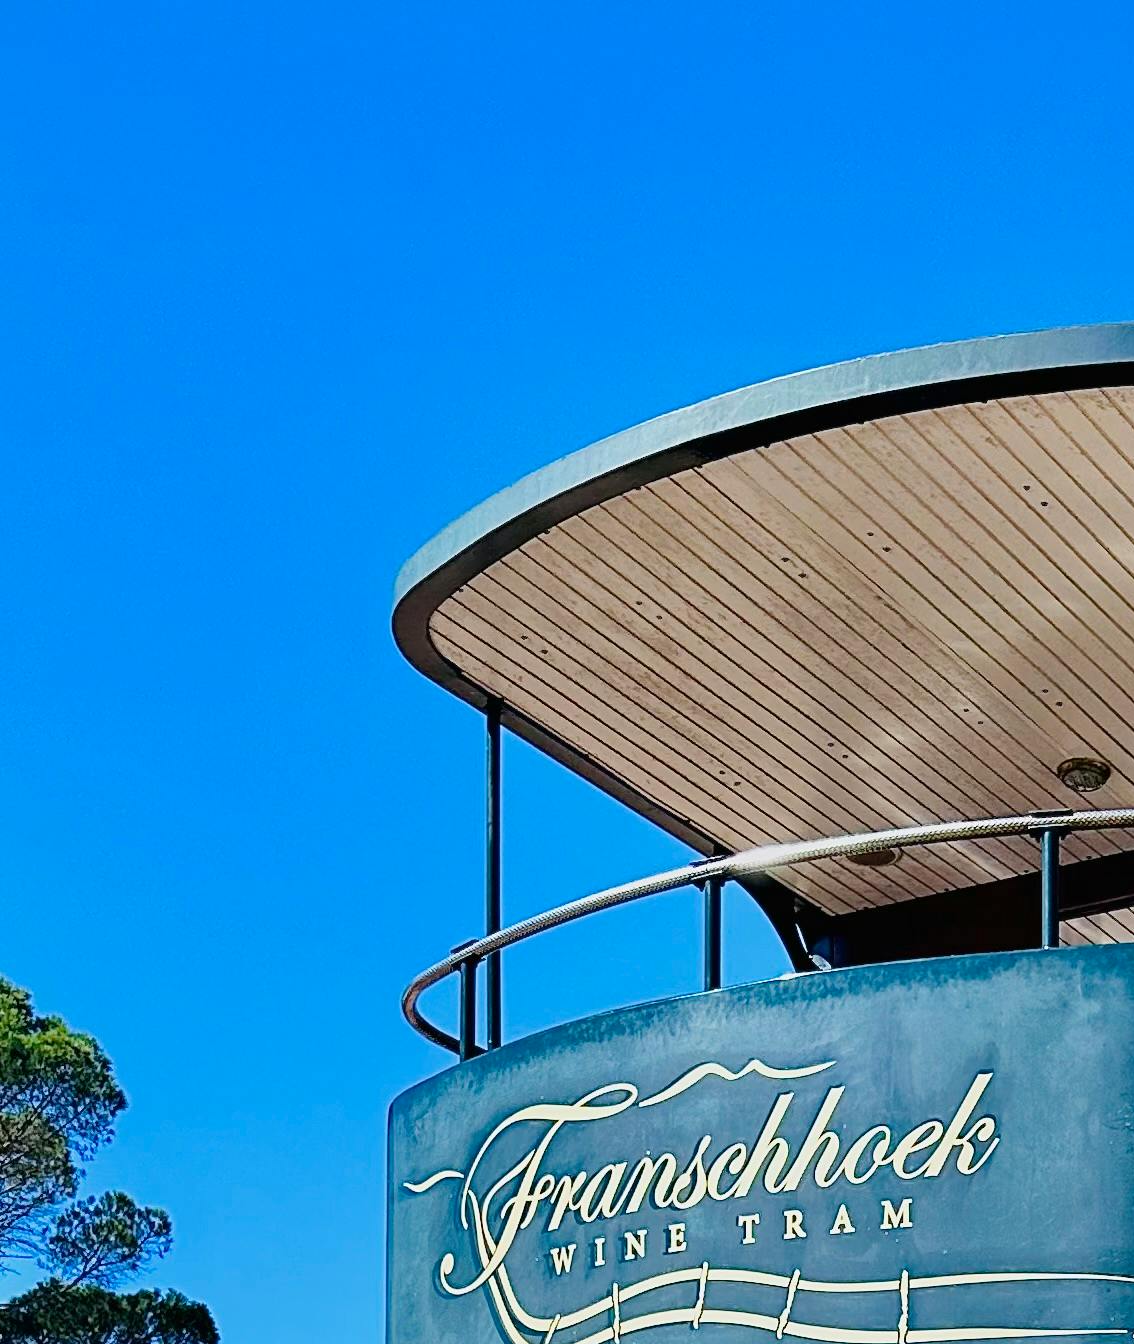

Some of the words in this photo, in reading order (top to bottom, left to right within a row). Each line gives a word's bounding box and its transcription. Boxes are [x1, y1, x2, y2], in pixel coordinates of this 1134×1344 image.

[440, 1073, 998, 1294] Franschhoek
[551, 1221, 687, 1275] WINE
[738, 1198, 913, 1244] TRAM
